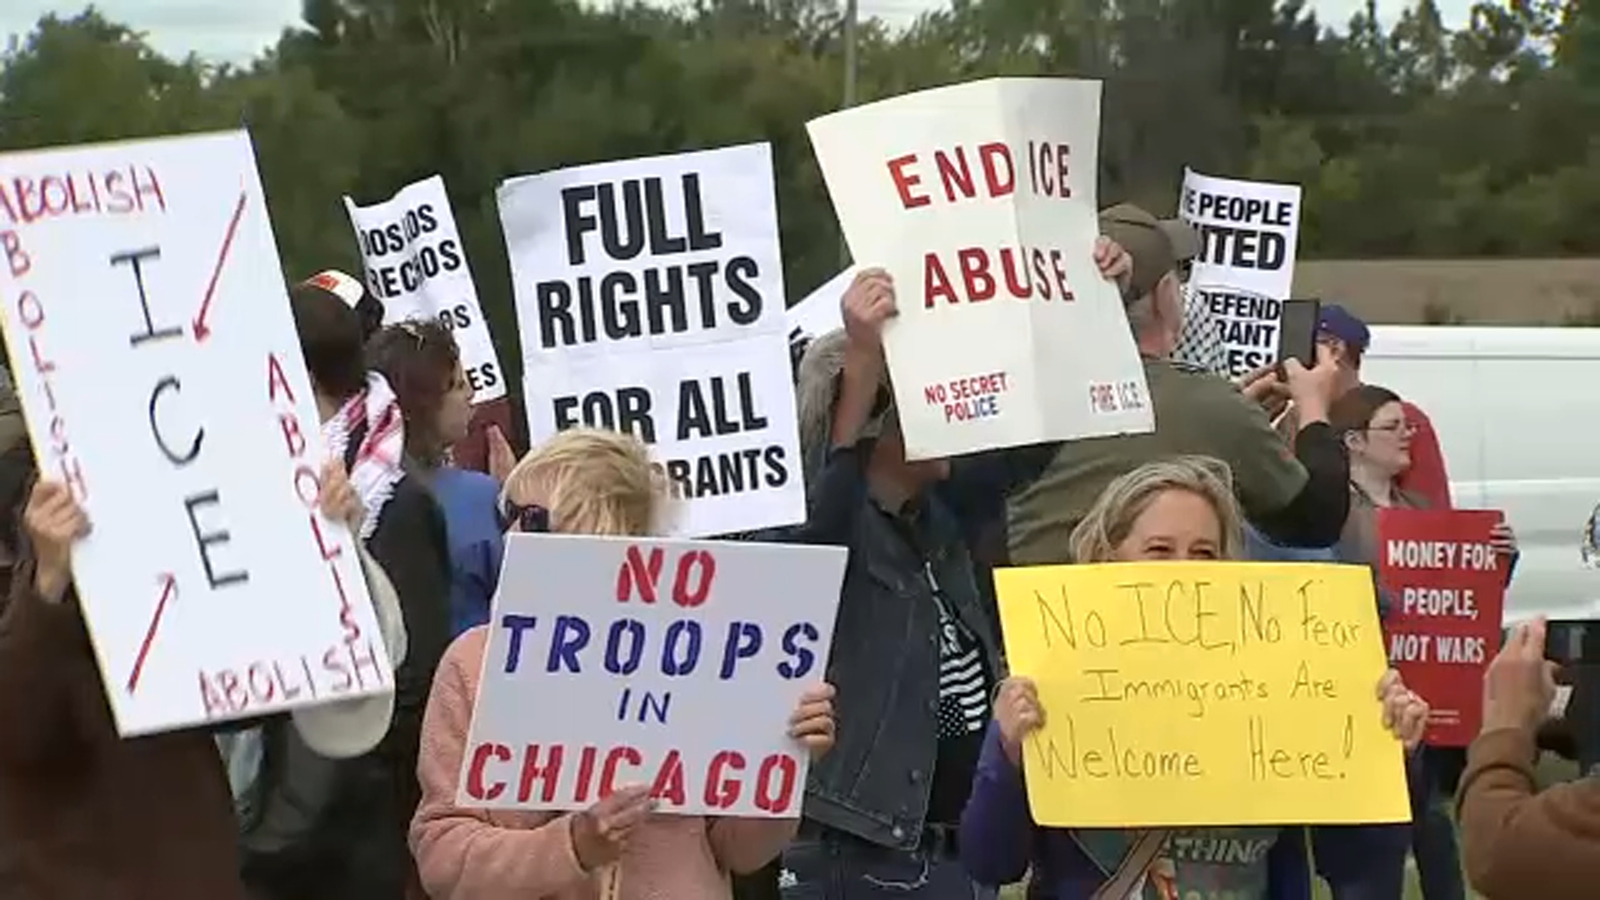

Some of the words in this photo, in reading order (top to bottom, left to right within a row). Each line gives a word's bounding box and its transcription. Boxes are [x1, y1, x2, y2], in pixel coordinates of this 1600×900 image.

[887, 142, 1016, 210] END
[1029, 140, 1071, 199] ICE
[561, 172, 722, 265] FULL
[1199, 192, 1292, 227] PEOPLE
[1193, 221, 1286, 270] ITED
[536, 256, 763, 348] RIGHTS
[924, 247, 1075, 309] ABUSE
[110, 246, 249, 590] ICE
[553, 387, 657, 444] FOR
[677, 372, 768, 441] ALL
[924, 384, 947, 405] NO
[950, 371, 1007, 401] SECRET
[945, 395, 999, 424] POLICE
[616, 545, 716, 607] NO
[1387, 539, 1456, 569] MONEY
[1460, 546, 1498, 571] FOR
[1034, 584, 1106, 650] No
[1239, 580, 1282, 644] No
[1297, 580, 1362, 647] Fear
[1403, 587, 1478, 620] PEOPLE,
[199, 636, 384, 717] ABOLISH
[502, 615, 819, 680] TROOPS
[1390, 634, 1431, 661] NOT
[1436, 636, 1485, 663] WARS
[618, 688, 671, 723] IN
[1080, 668, 1268, 717] Immigrants
[1290, 660, 1338, 699] Are
[465, 742, 797, 814] CHICAGO
[1031, 715, 1203, 781] Welcome
[1249, 714, 1354, 782] Here!
